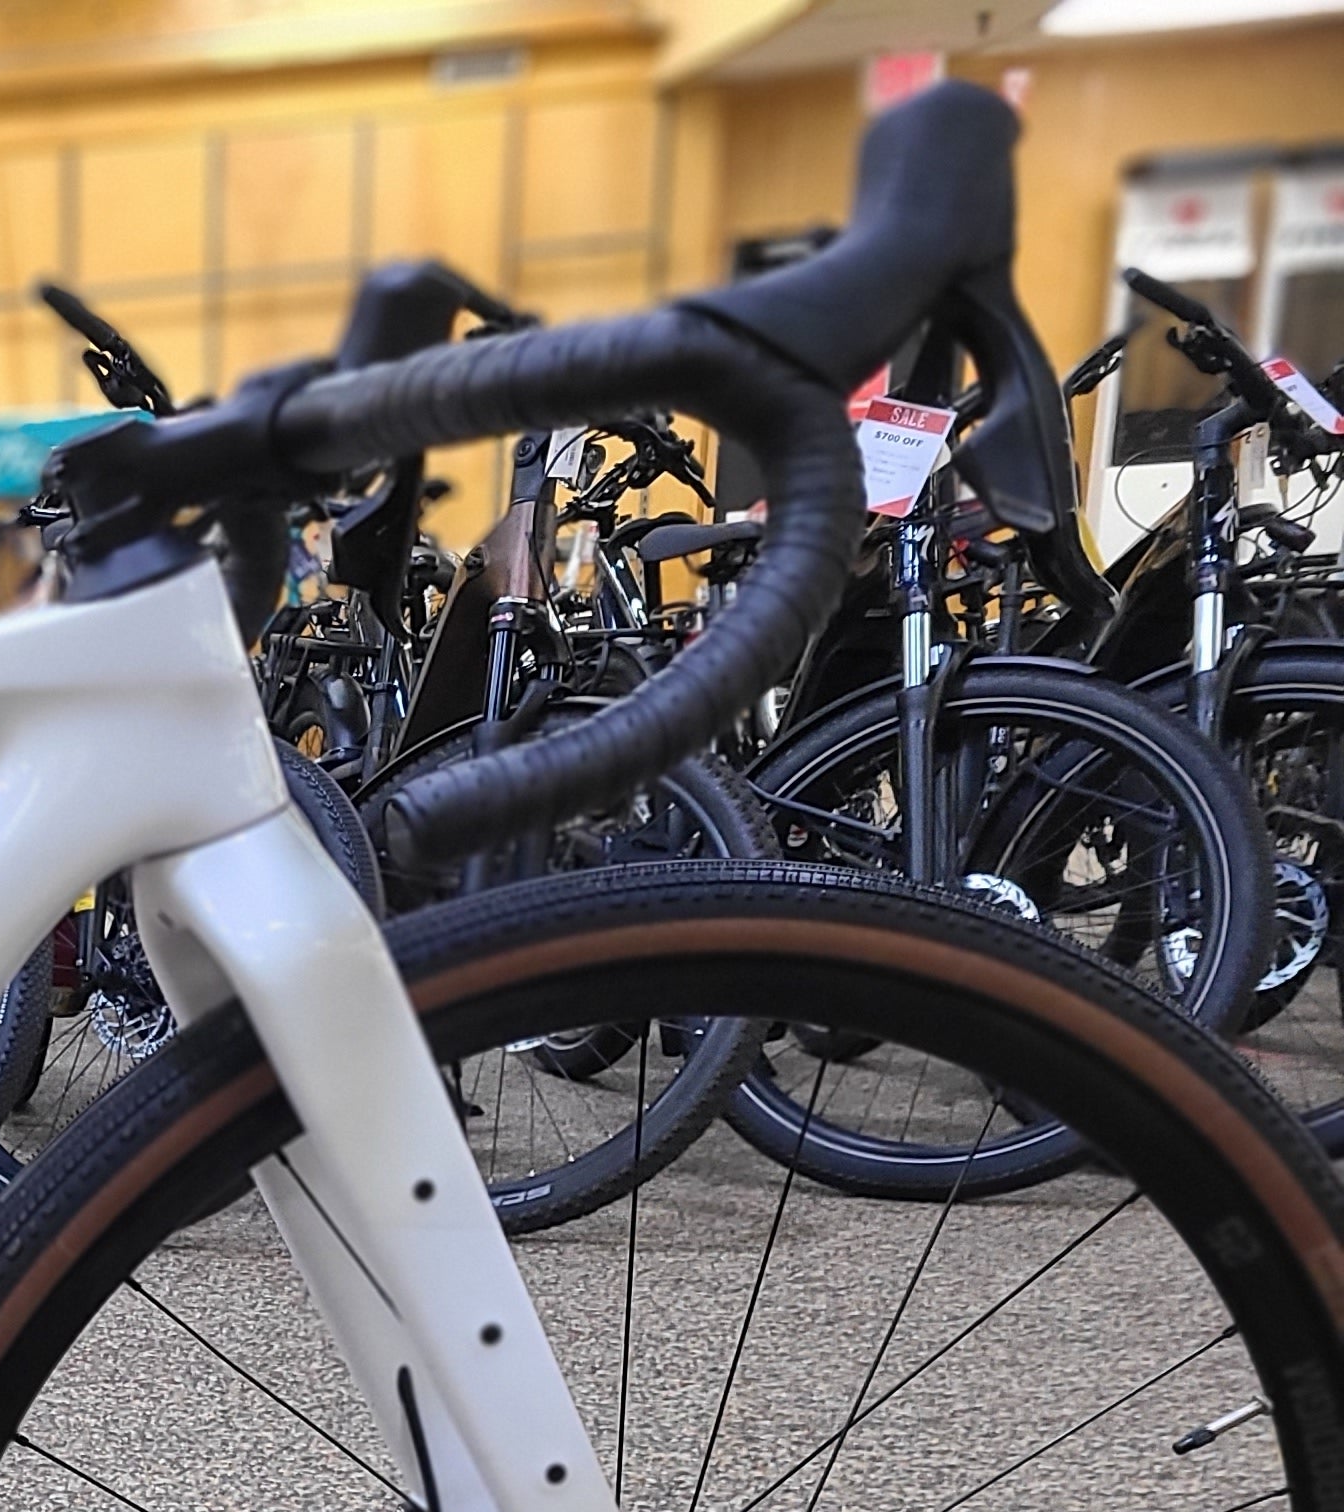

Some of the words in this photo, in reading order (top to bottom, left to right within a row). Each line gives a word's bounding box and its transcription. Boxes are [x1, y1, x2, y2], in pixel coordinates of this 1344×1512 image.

[890, 406, 929, 429] SALE
[874, 430, 901, 443] $700
[903, 437, 924, 448] OFF
